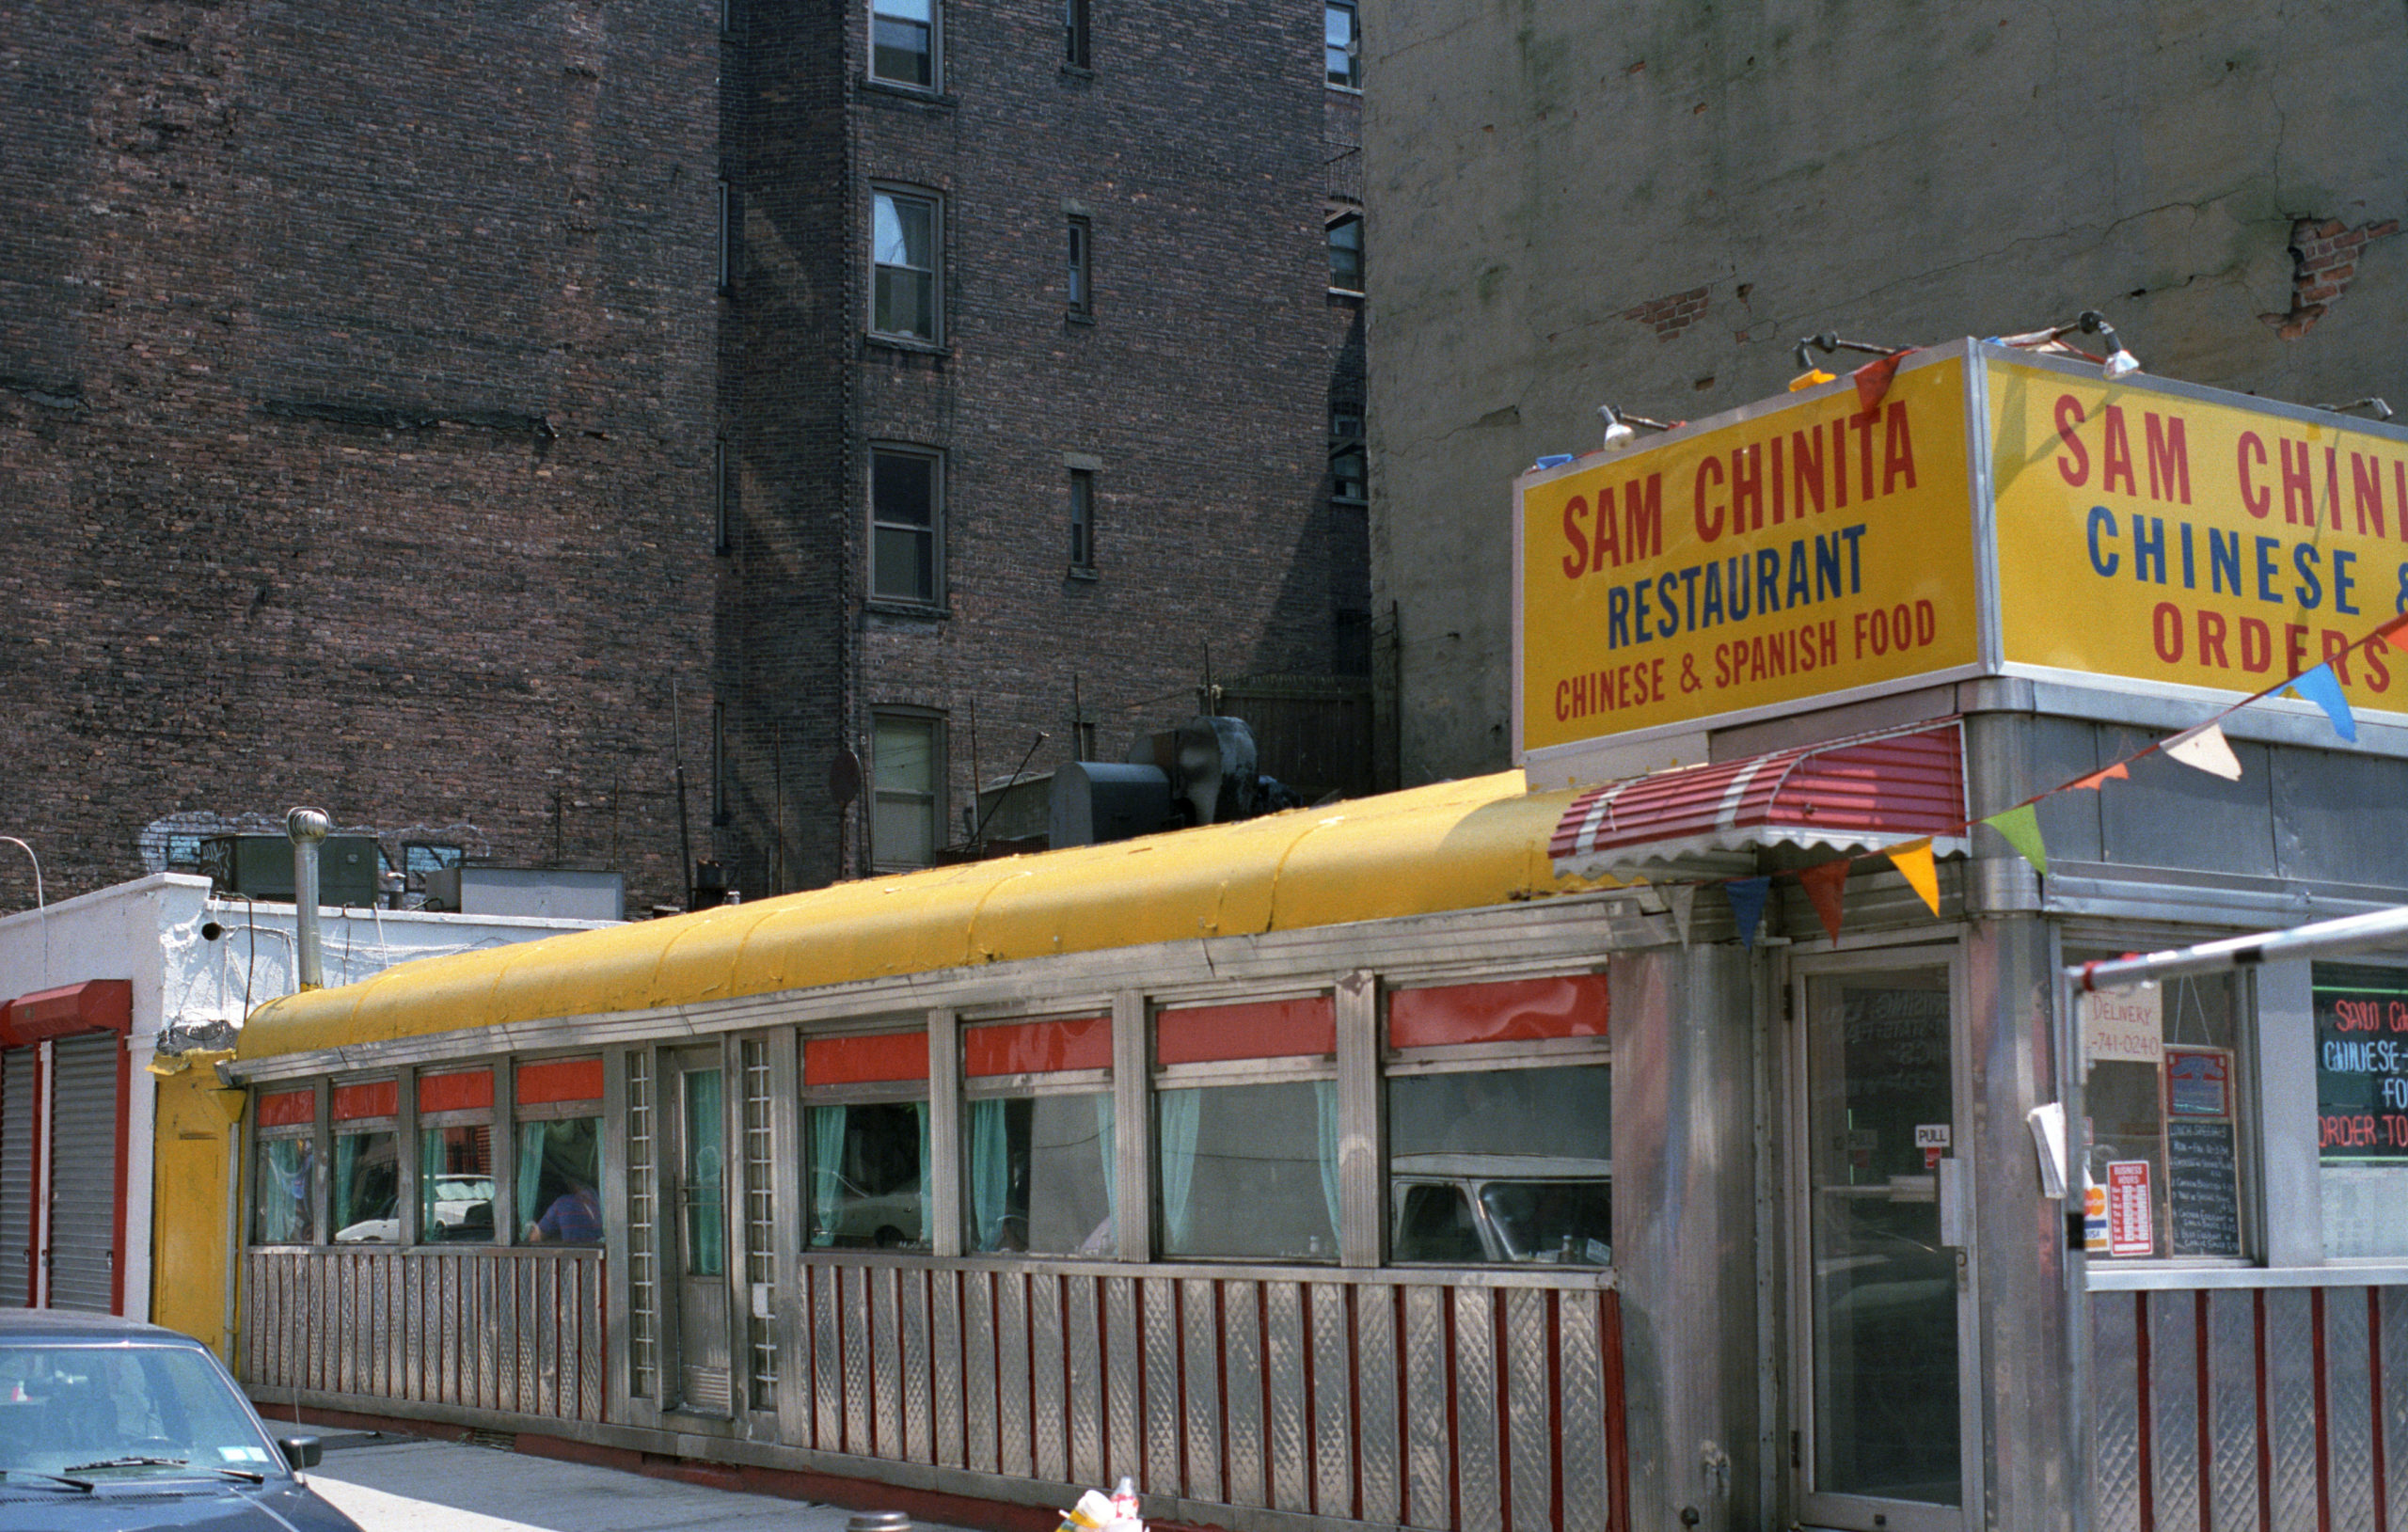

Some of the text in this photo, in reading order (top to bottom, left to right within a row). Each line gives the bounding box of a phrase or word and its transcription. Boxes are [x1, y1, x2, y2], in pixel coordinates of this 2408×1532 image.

[1562, 400, 1917, 579] SAM CHINITA
[2054, 394, 2192, 505] SAM
[1608, 524, 1866, 650] RESTAURANT
[2087, 505, 2360, 615] CHINESE
[1556, 599, 1936, 721] CHINESE & SPANISH FOOD
[2153, 602, 2390, 692] ORDERS
[2335, 999, 2381, 1033] SAM
[1919, 1129, 1947, 1142] PULL
[2318, 1115, 2377, 1147] ORDER
